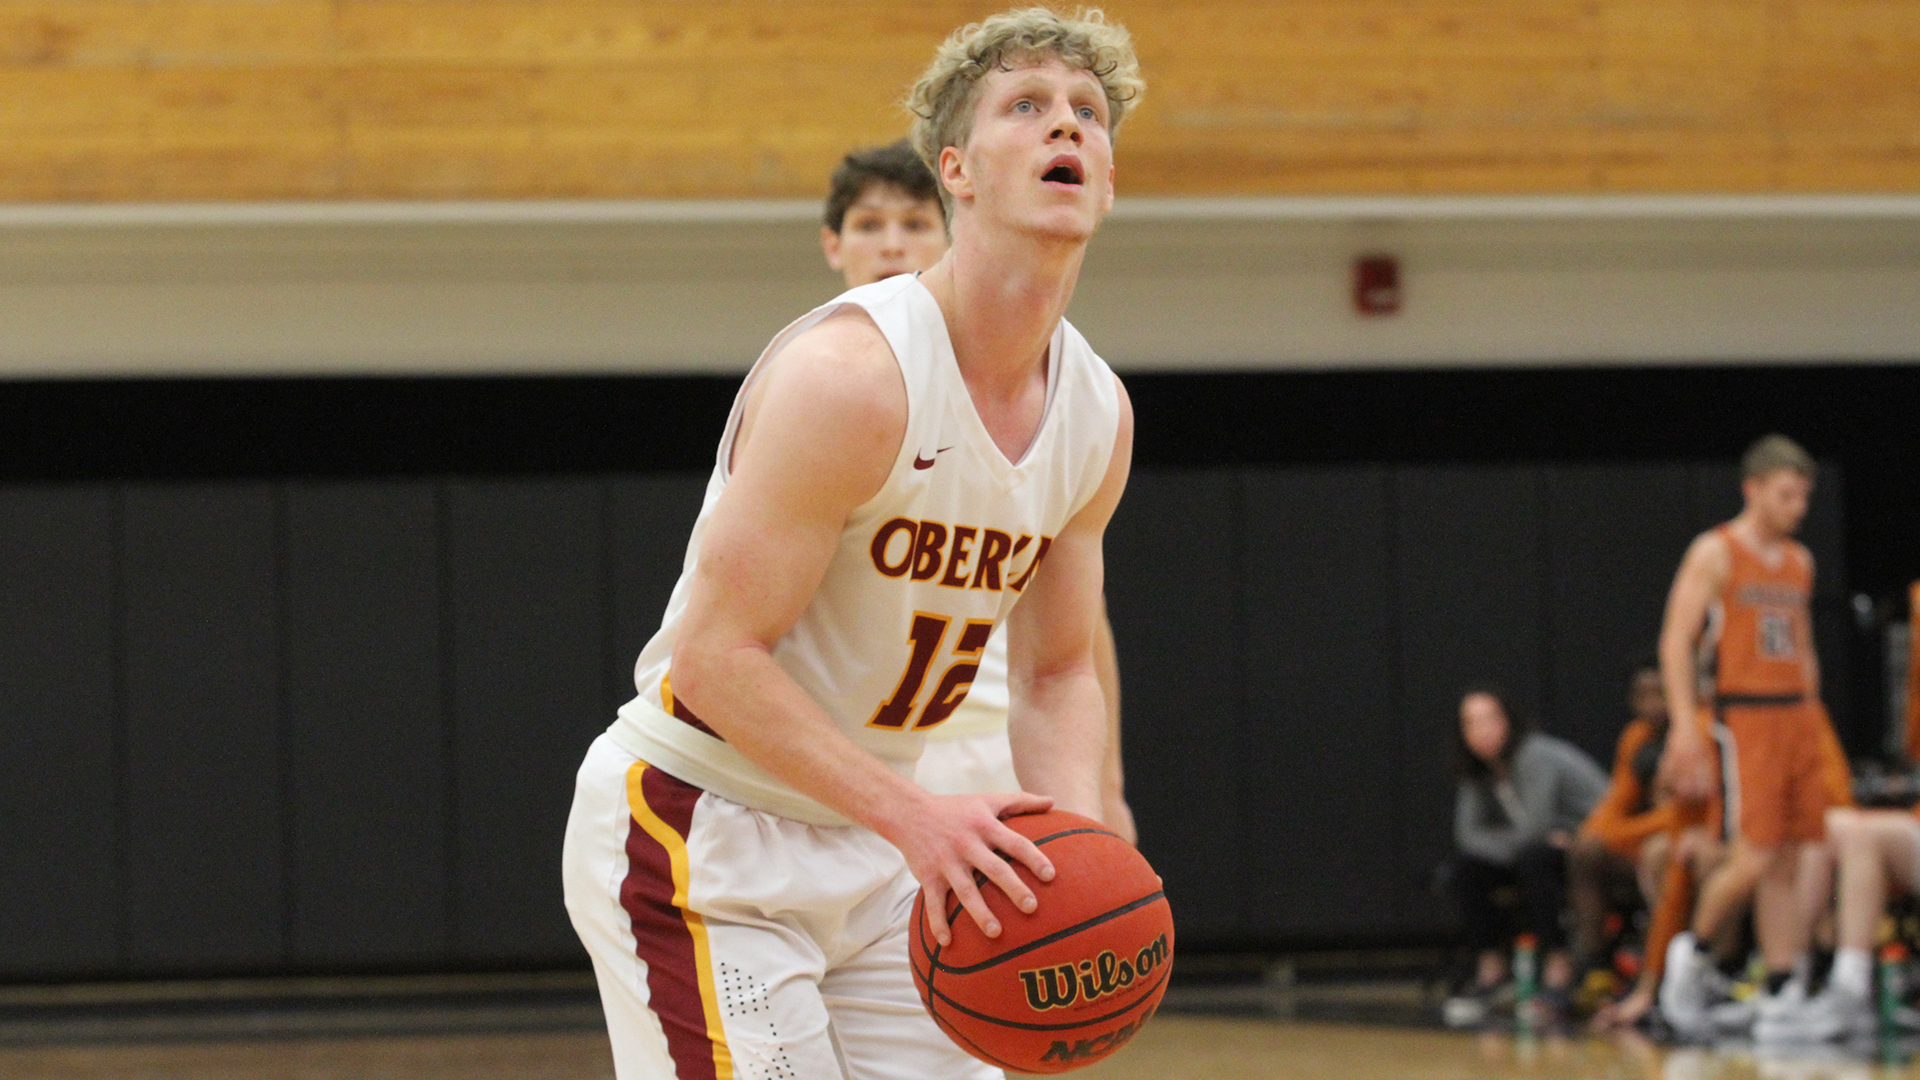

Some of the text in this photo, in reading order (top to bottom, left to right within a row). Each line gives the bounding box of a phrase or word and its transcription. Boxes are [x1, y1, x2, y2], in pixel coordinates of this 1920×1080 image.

[869, 516, 1053, 593] OBERN
[865, 610, 995, 732] 12
[1019, 932, 1169, 1012] Wilson
